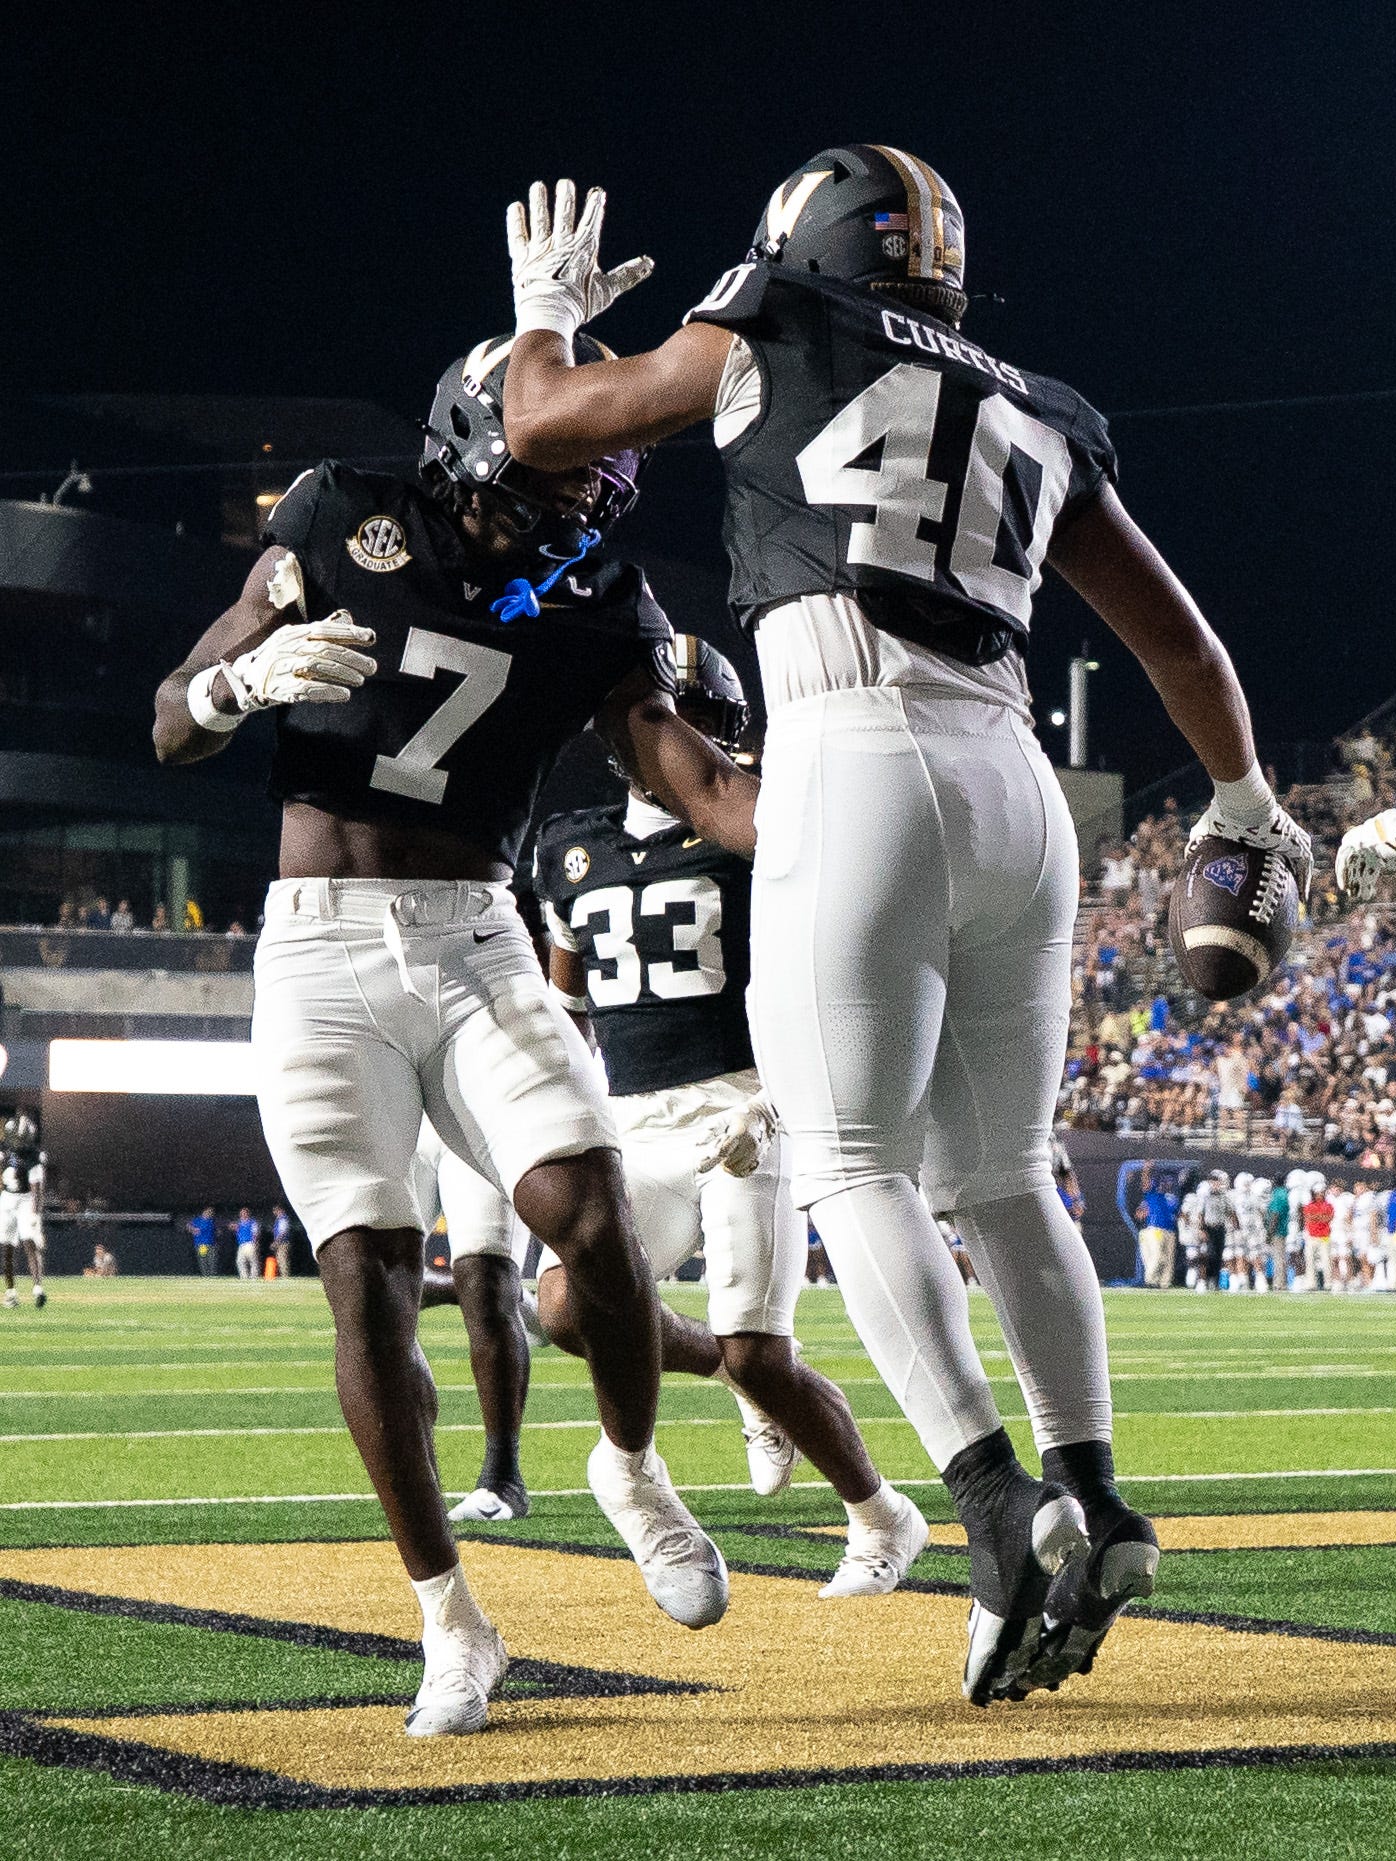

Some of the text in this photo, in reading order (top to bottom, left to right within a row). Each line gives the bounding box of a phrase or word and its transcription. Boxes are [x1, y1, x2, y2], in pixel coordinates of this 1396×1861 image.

[881, 309, 1029, 395] CURTIS
[361, 519, 402, 558] SEC
[796, 362, 1072, 629] 40
[351, 548, 400, 570] GRADUATE
[369, 626, 513, 804] 7
[570, 877, 727, 1008] 33
